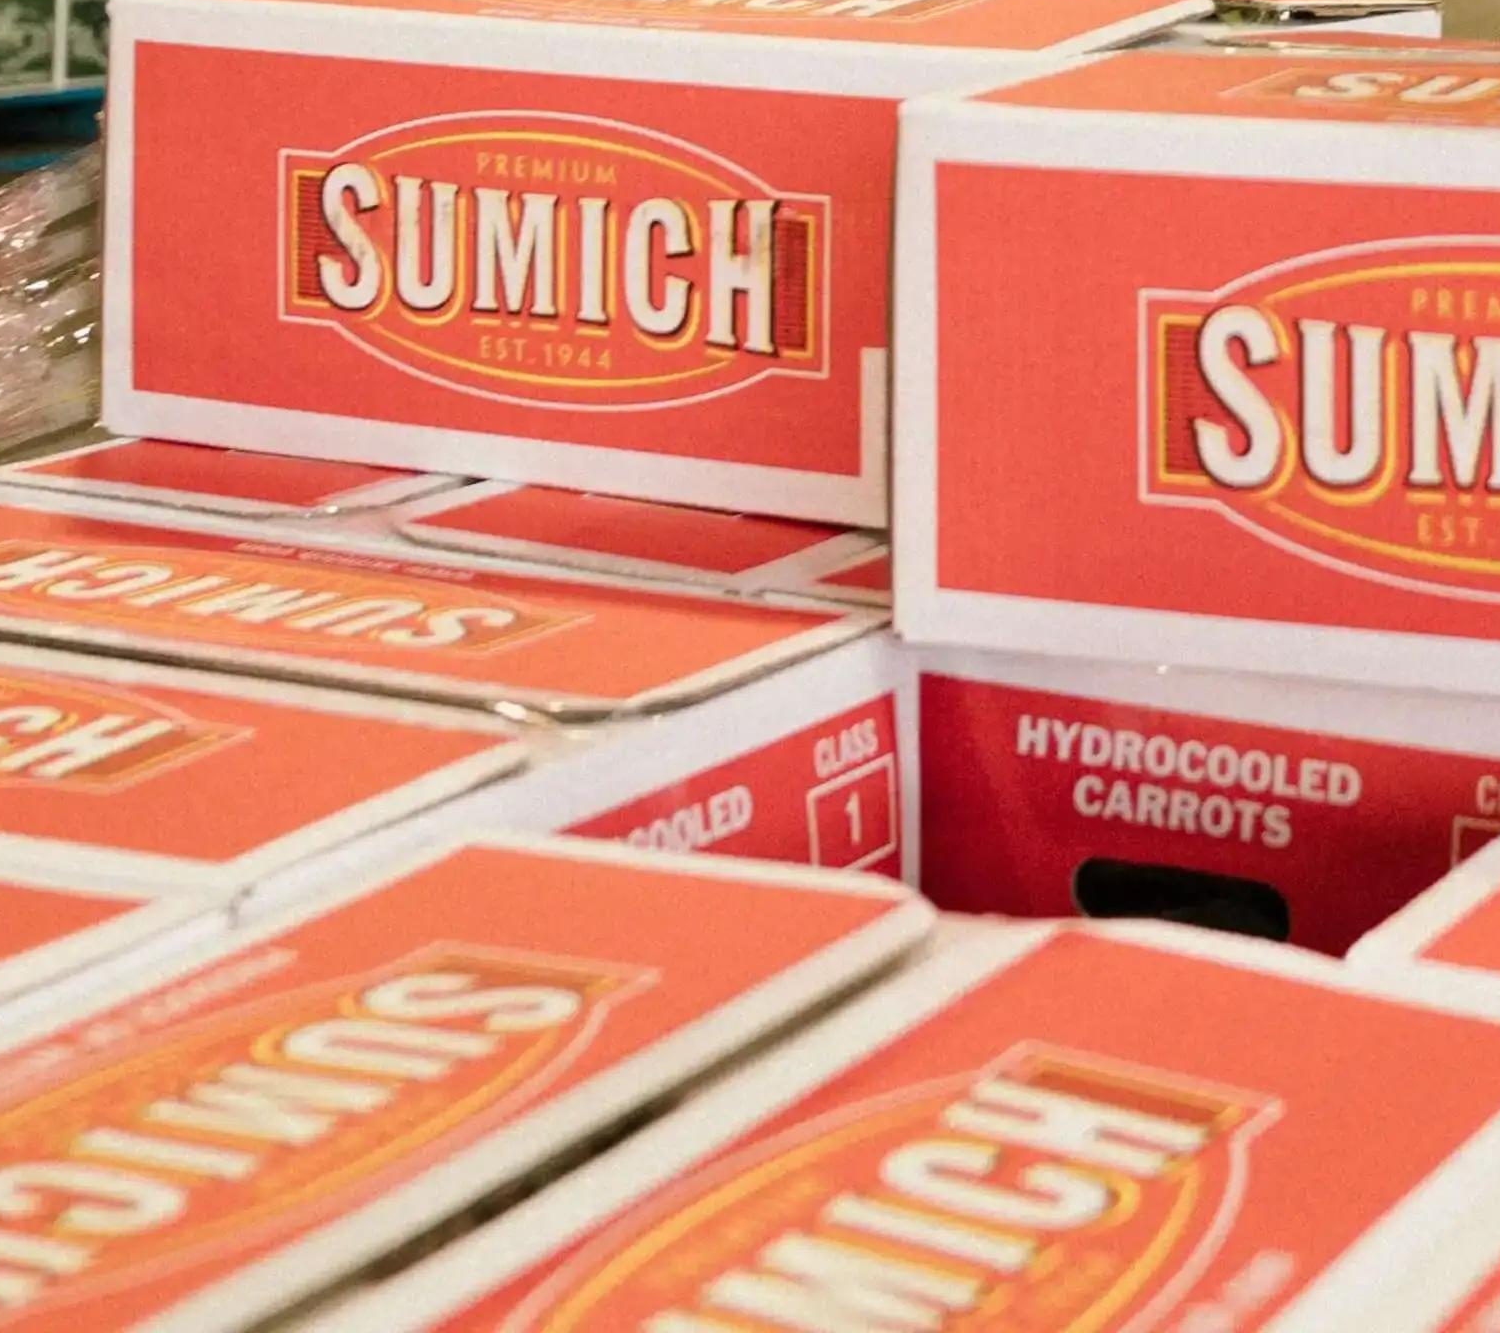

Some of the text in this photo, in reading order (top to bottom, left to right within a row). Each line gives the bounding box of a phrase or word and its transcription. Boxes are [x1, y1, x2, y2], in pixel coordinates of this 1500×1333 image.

[476, 152, 617, 186] PREMIUM
[317, 161, 782, 357] SUMICH
[813, 719, 878, 779] CLASS
[1016, 713, 1362, 808] HYDROCOOLED
[842, 791, 863, 846] 1
[1073, 775, 1292, 849] CARROTS
[630, 1077, 1210, 1333] MICH
